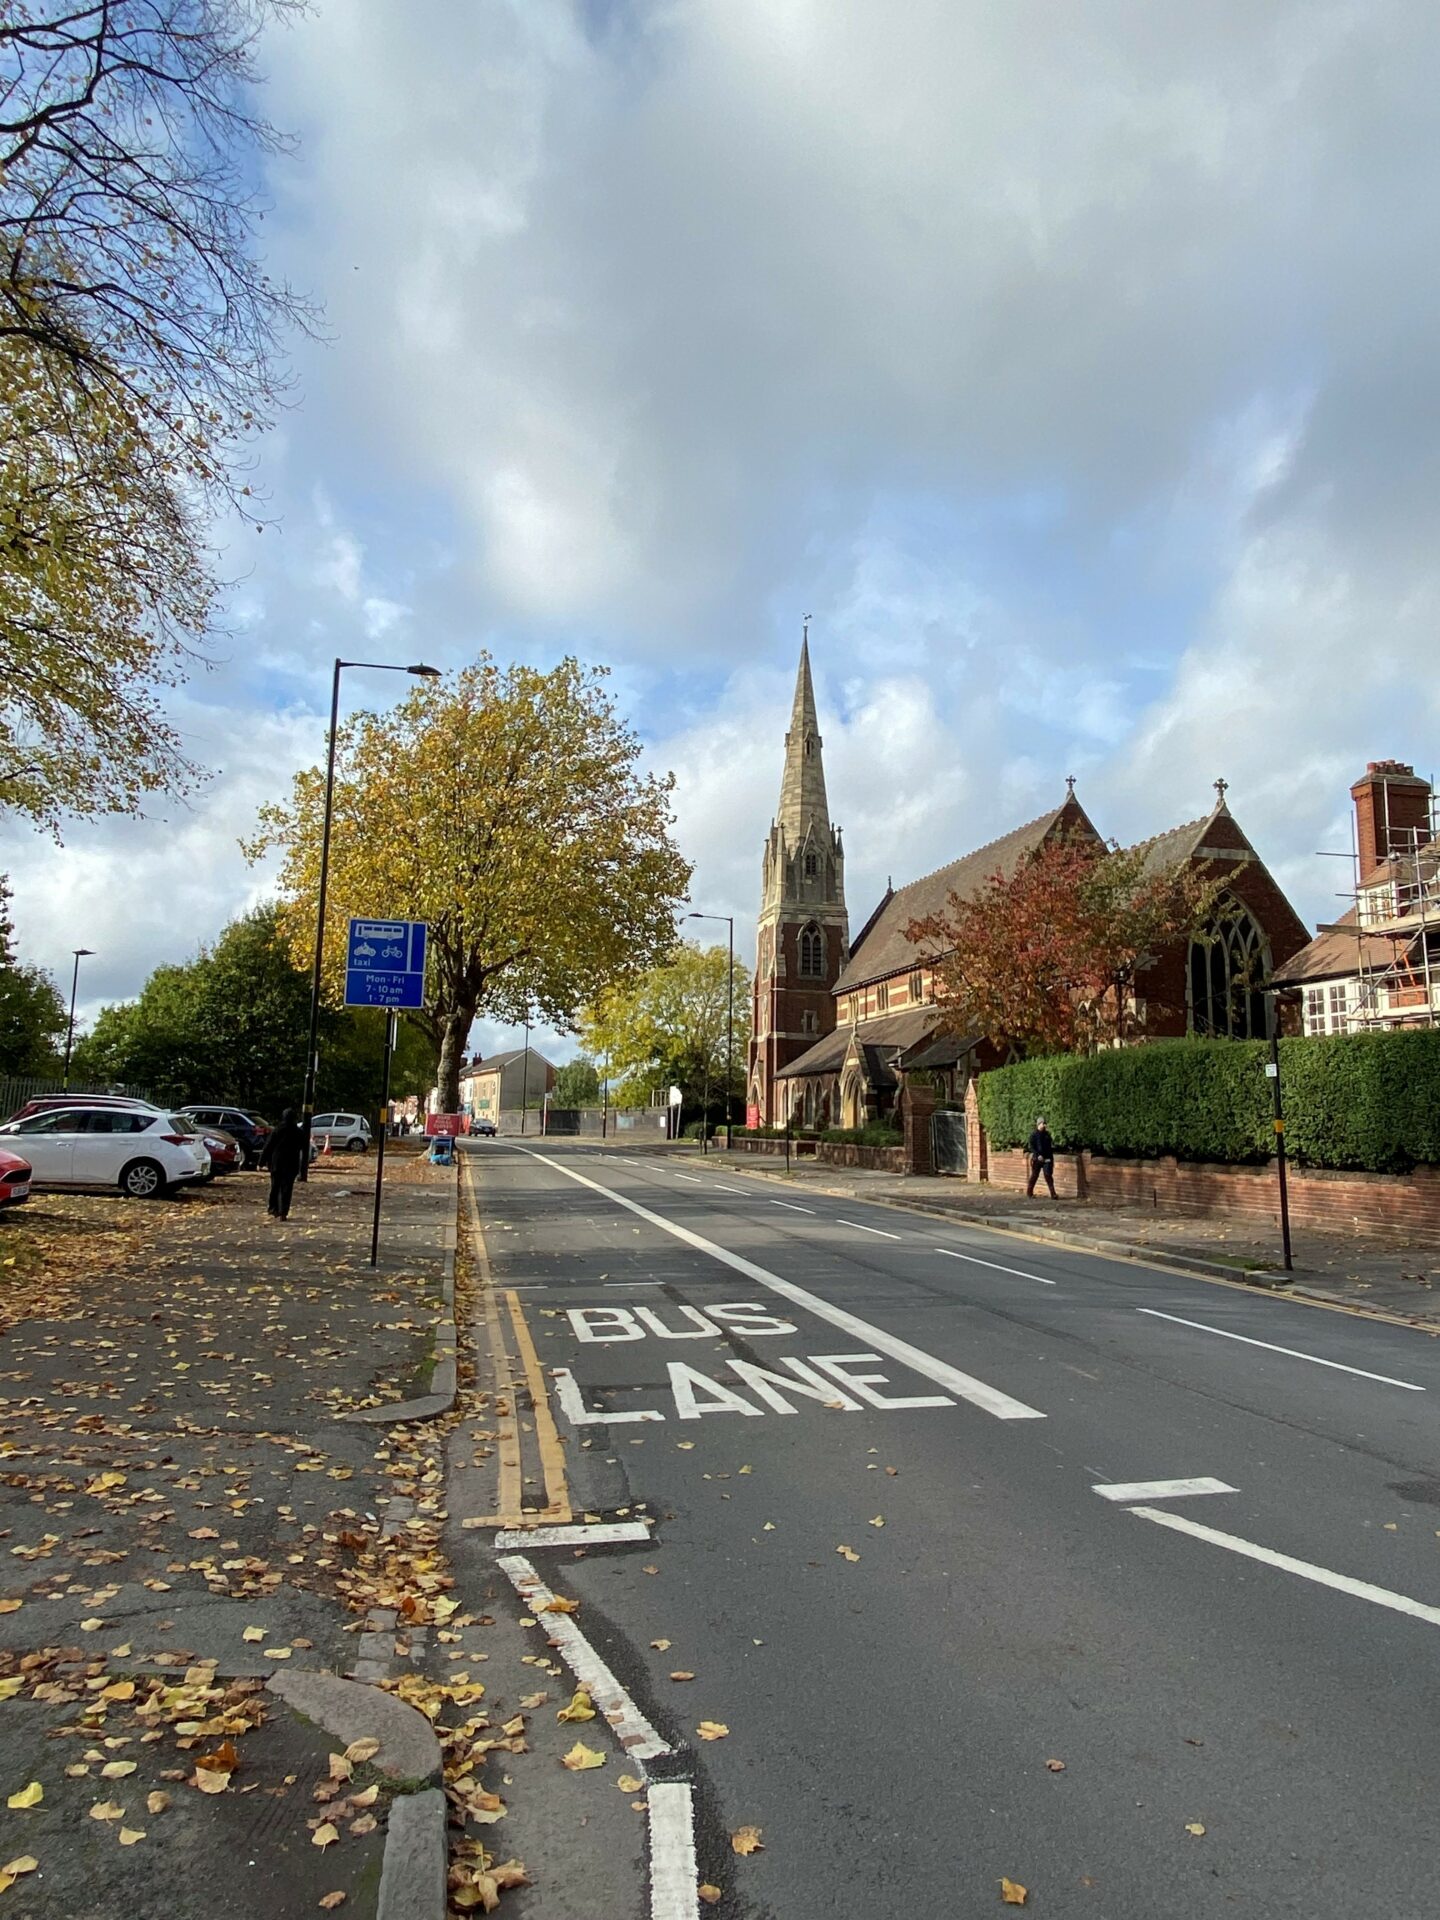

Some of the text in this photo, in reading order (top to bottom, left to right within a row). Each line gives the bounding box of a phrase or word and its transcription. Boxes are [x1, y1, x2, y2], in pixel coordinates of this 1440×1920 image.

[354, 958, 371, 966] taxi
[366, 975, 386, 983] Mon
[392, 976, 405, 984] Fri
[566, 1303, 798, 1343] BUS
[552, 1353, 957, 1425] LANE
